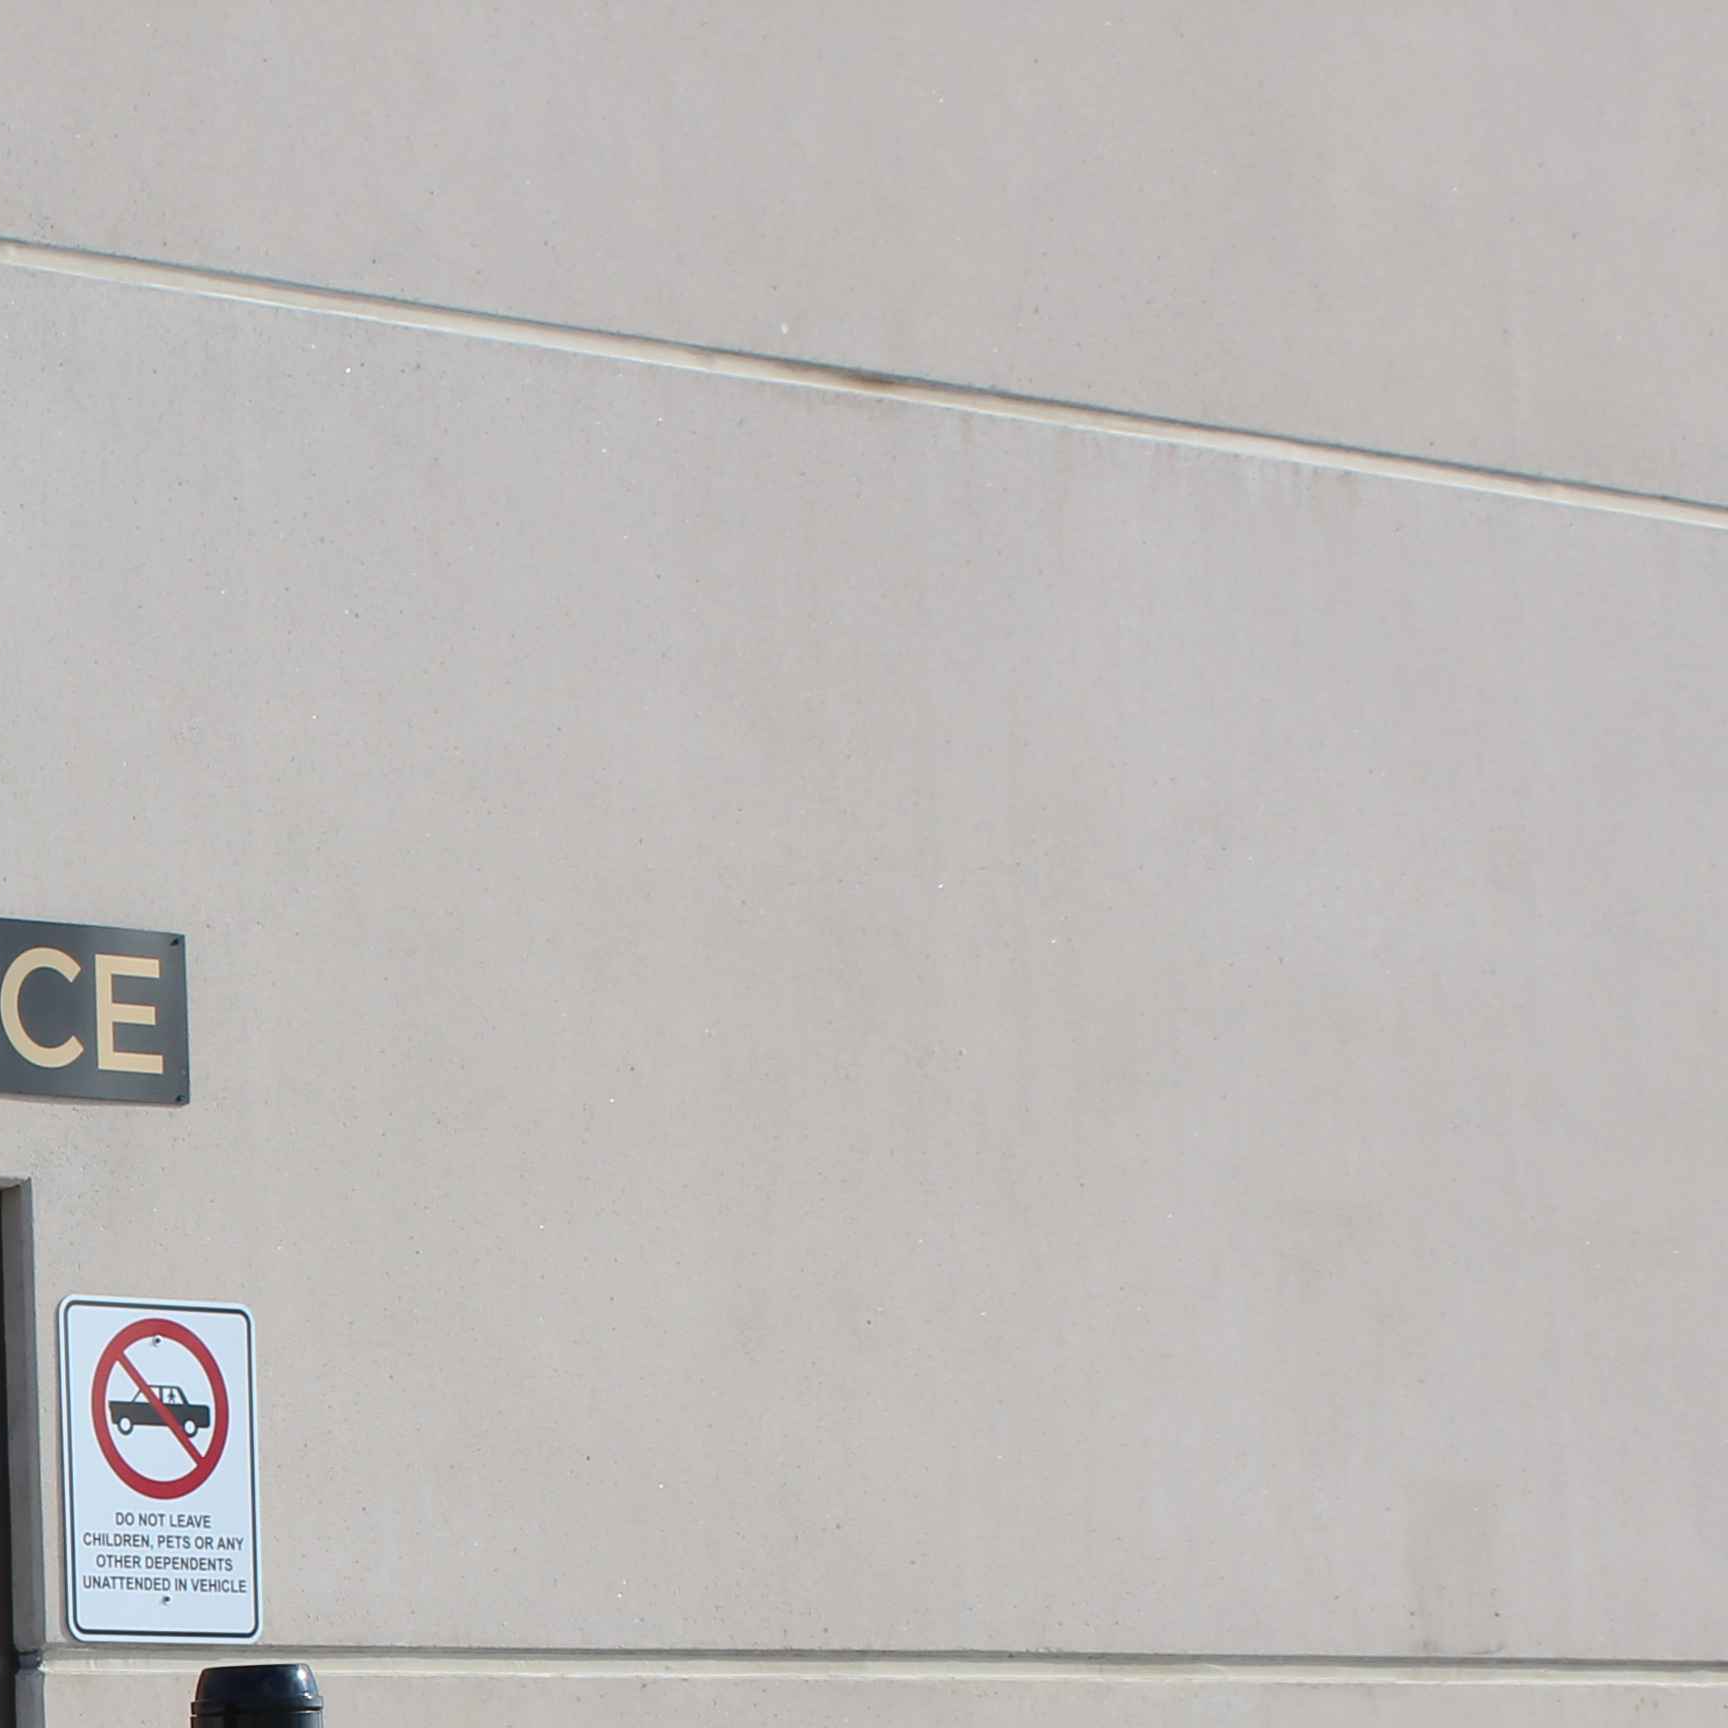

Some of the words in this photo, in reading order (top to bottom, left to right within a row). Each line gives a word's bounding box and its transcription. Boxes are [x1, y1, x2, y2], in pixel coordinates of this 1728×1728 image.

[115, 1511, 135, 1527] DO
[138, 1512, 166, 1528] NOT
[169, 1513, 212, 1529] LEAVE
[82, 1532, 155, 1550] CHILDREN,
[157, 1534, 192, 1551] PETS
[194, 1535, 215, 1551] OR
[216, 1536, 245, 1552] ANY
[95, 1554, 142, 1571] OTHER
[144, 1555, 234, 1573] DEPENDENTS
[82, 1575, 172, 1592] UNATTENDED
[174, 1577, 189, 1593] IN
[191, 1578, 247, 1595] VEHICLE
